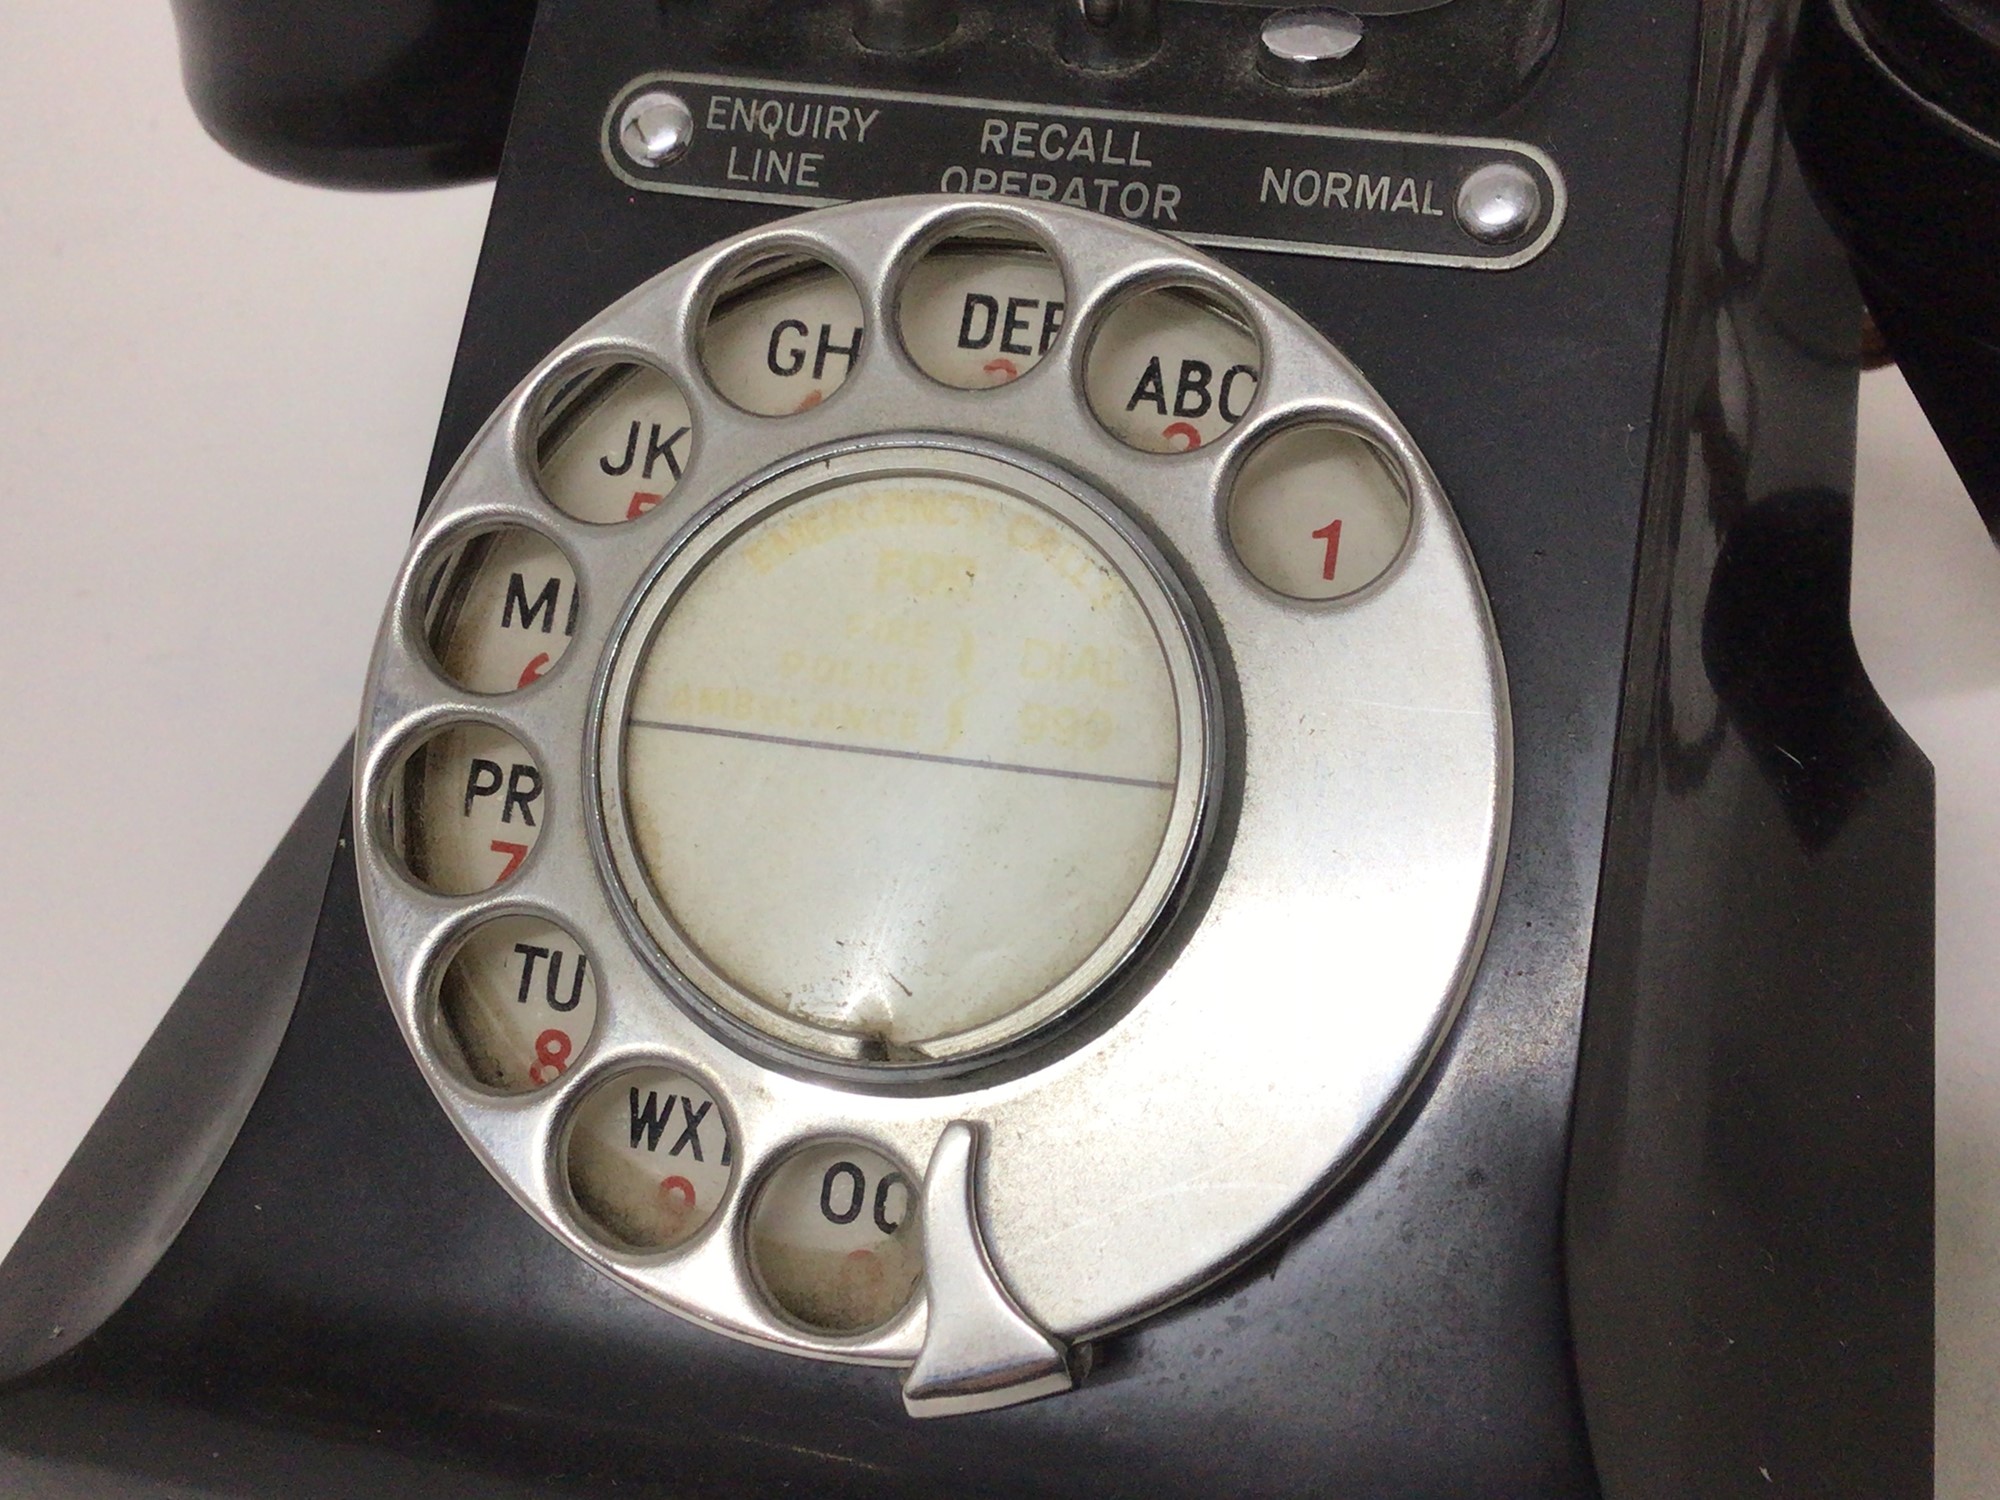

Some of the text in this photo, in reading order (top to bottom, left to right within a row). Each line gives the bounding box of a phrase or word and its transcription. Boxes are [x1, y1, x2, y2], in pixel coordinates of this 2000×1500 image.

[706, 95, 880, 143] ENQUIRY
[980, 118, 1153, 168] RECALL
[726, 146, 825, 188] LINE
[941, 165, 1182, 222] OPERATOR
[1260, 167, 1443, 216] NORMAL
[767, 319, 863, 380] GH
[1126, 356, 1258, 424] ABC
[600, 420, 690, 481] JK
[873, 548, 980, 600] FOR
[1312, 519, 1342, 580] 1
[1018, 637, 1128, 689] DIAL
[465, 759, 543, 827] PR
[490, 840, 529, 885] 7
[514, 943, 587, 1012] TU
[529, 1029, 572, 1085] 8
